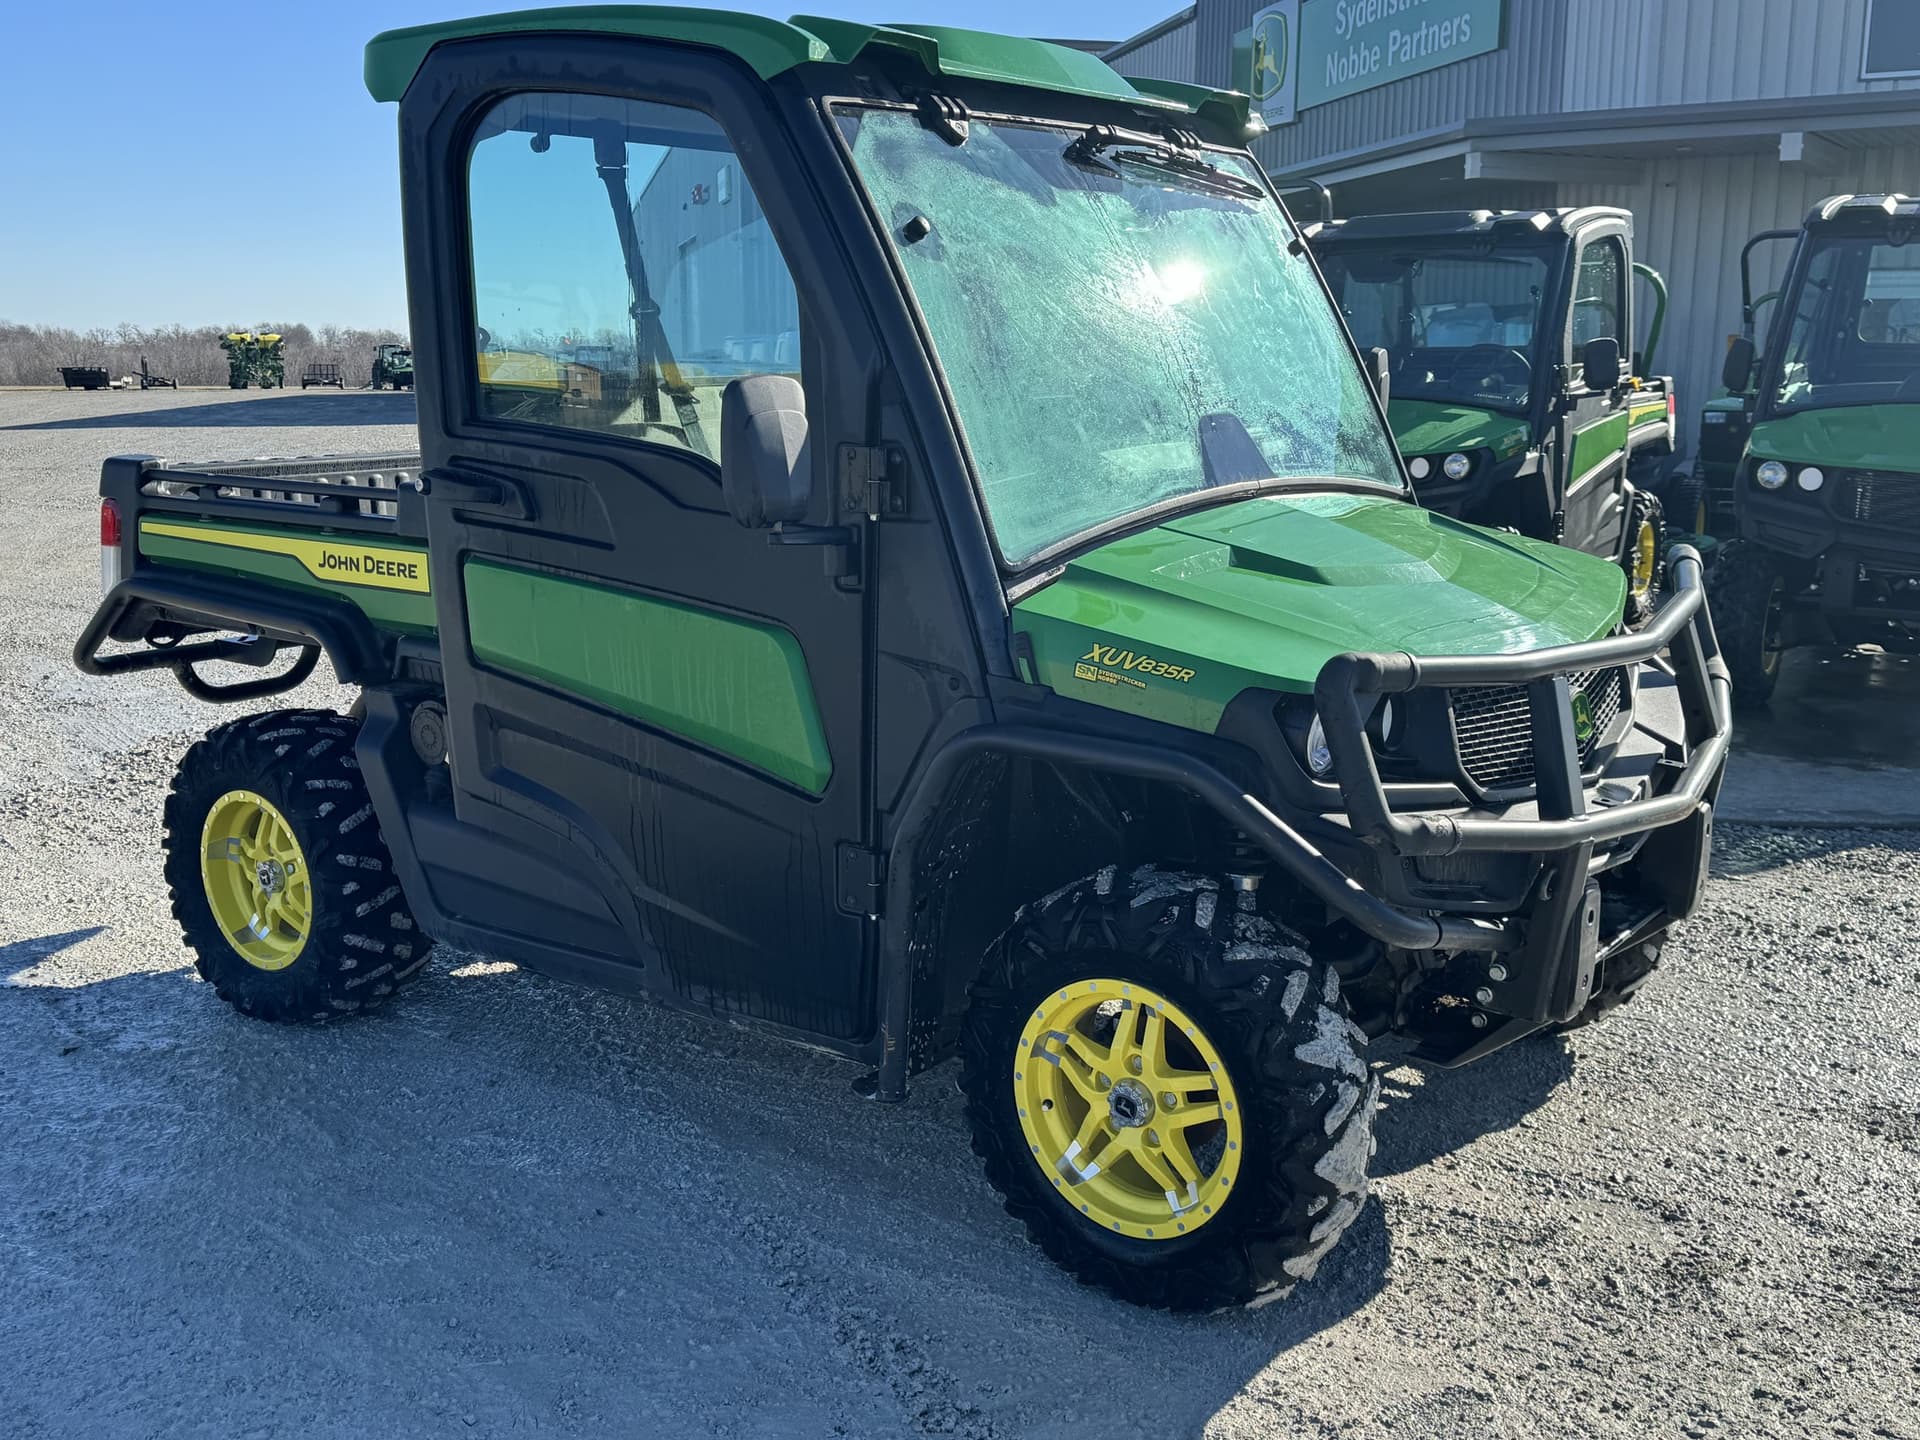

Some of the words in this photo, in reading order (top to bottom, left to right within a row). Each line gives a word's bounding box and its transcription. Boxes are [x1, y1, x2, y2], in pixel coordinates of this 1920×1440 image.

[1325, 41, 1380, 88] Nobbe
[1387, 13, 1471, 67] Partners
[318, 550, 360, 572] JOHN
[364, 555, 418, 579] DEERE
[1077, 664, 1097, 677] SN
[1082, 643, 1196, 682] XUV835R
